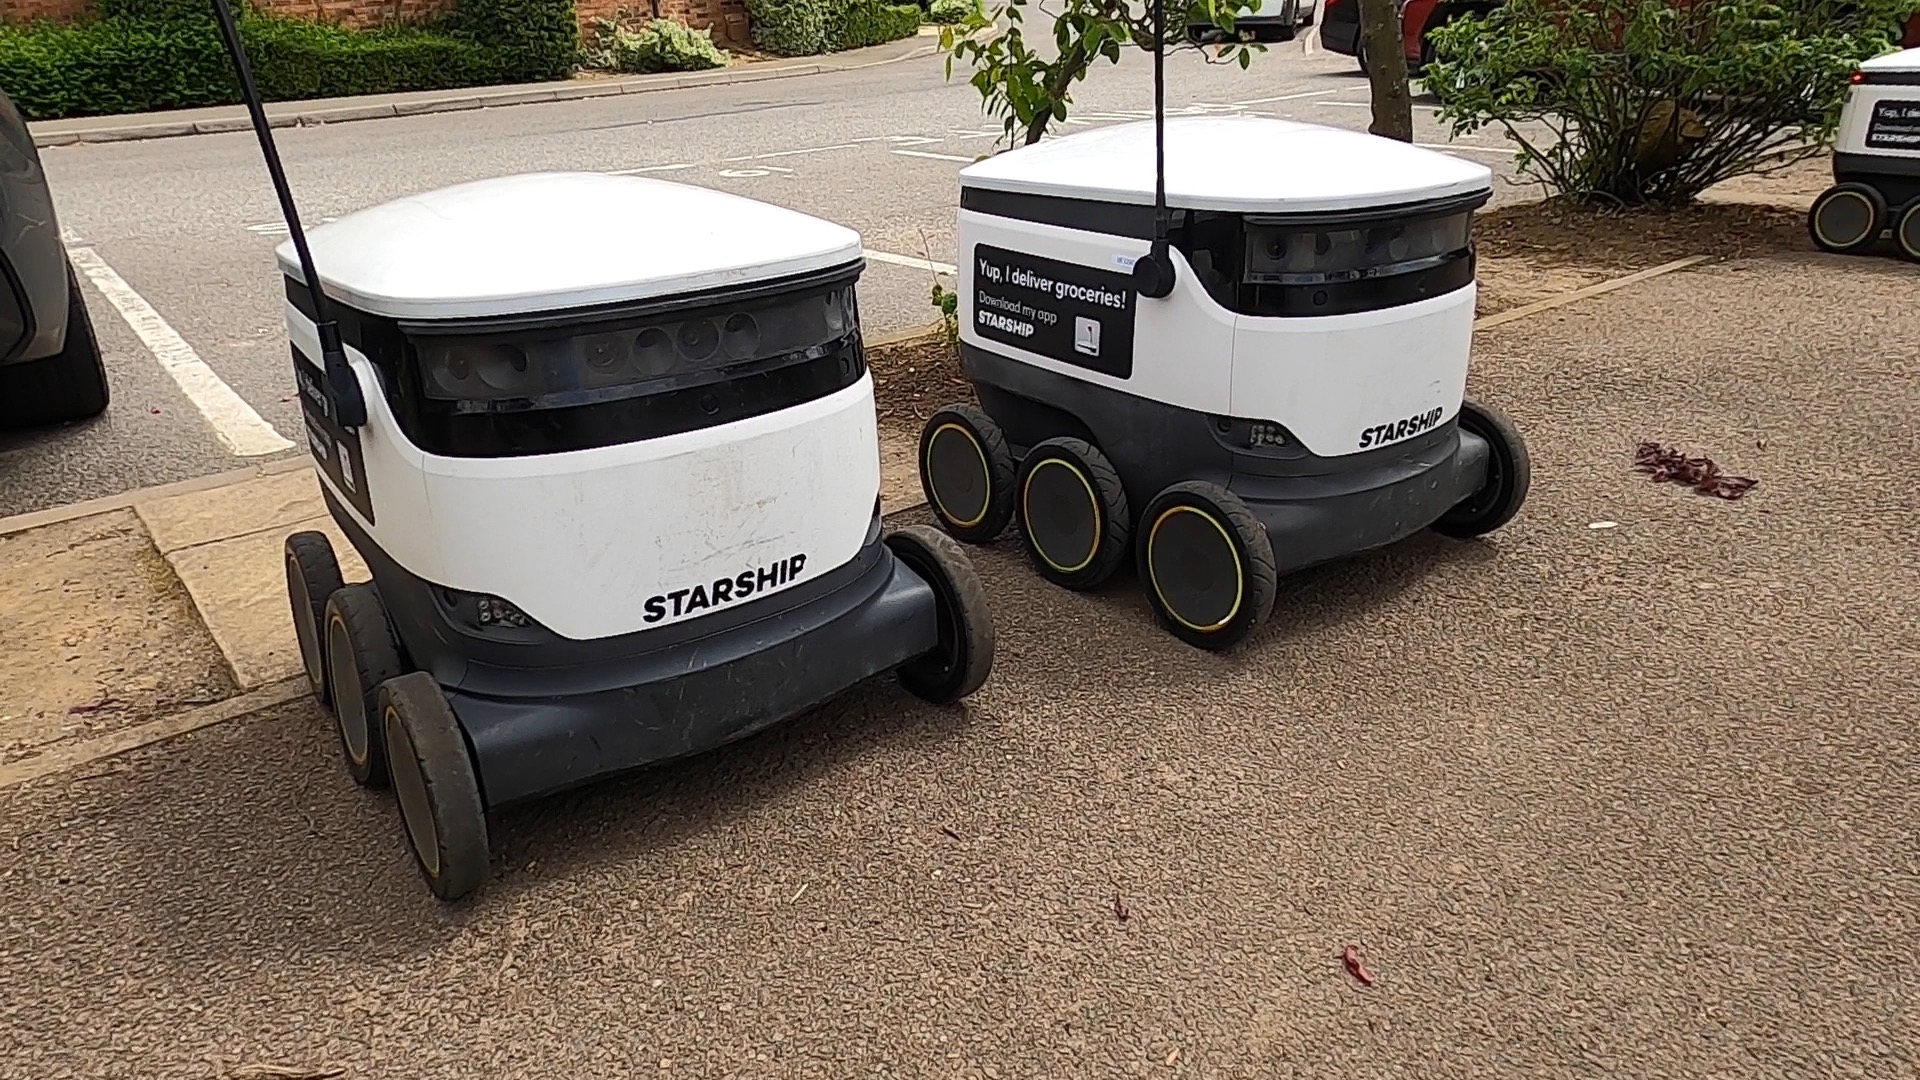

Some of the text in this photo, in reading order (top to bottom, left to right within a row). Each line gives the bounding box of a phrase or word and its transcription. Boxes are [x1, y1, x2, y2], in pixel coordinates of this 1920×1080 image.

[979, 258, 1127, 309] Yup, I deliver groceries!
[978, 310, 1035, 337] STARSHIP
[979, 290, 1058, 326] Download my app
[1359, 406, 1443, 448] STARSHIP
[643, 553, 807, 623] STARSHIP
